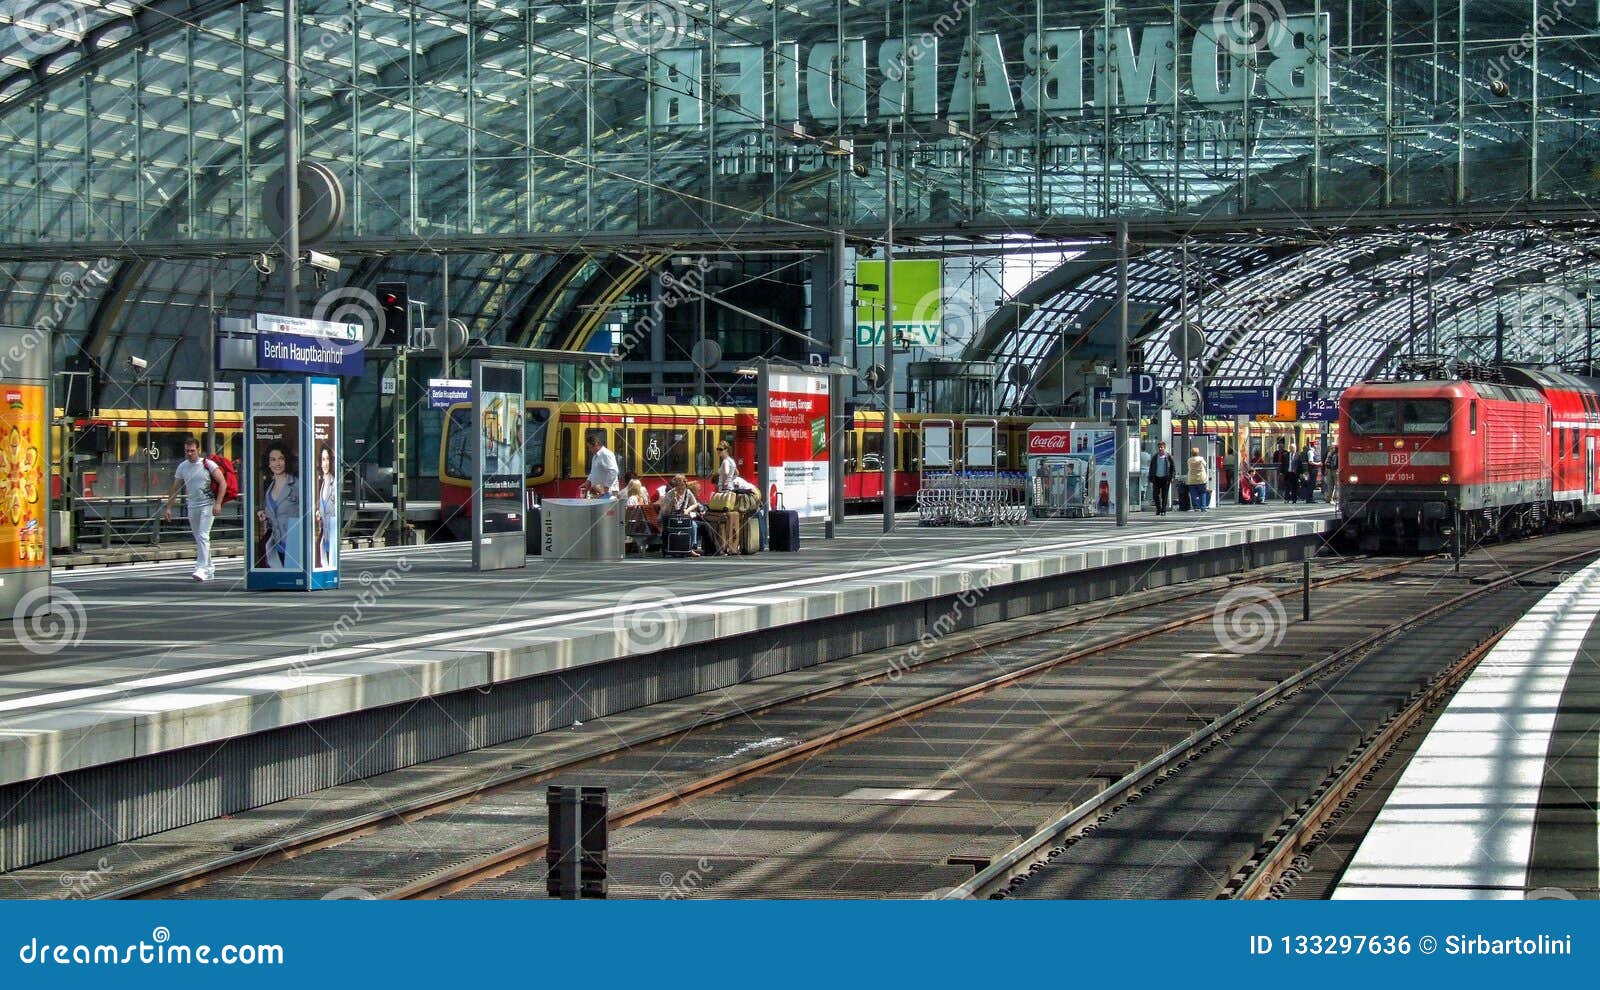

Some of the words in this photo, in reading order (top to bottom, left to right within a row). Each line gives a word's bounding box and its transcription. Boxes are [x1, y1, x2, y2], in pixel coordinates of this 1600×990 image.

[857, 325, 941, 345] DATEV
[264, 340, 288, 359] Berlin
[290, 343, 344, 365] Hauptbahnhof
[1139, 374, 1154, 393] D
[769, 397, 781, 408] Guten
[1392, 454, 1407, 464] DB
[545, 519, 553, 552] Abfall
